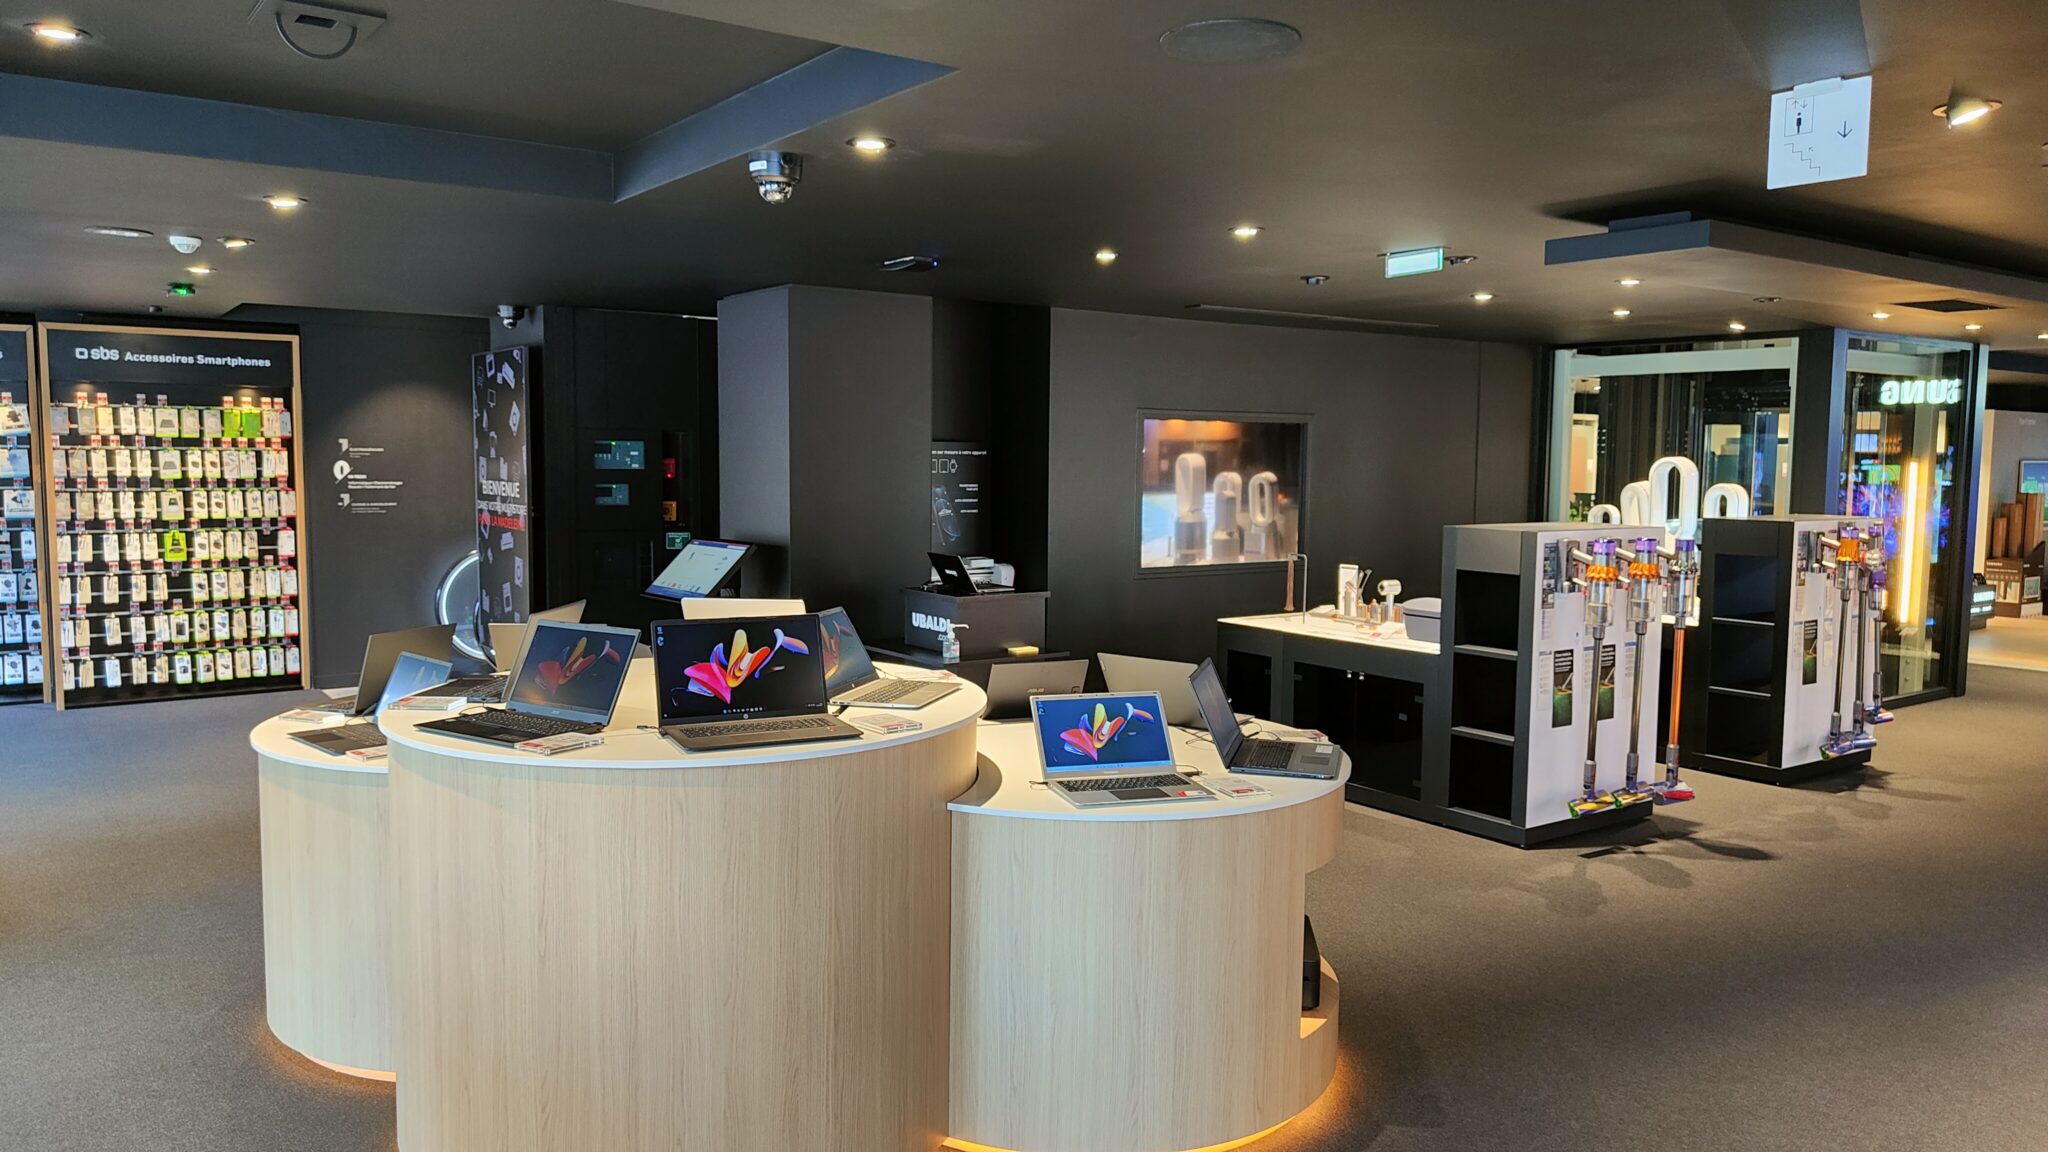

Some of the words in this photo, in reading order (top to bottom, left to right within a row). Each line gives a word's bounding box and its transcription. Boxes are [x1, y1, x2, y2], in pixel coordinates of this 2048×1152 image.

[90, 346, 119, 361] sbs
[124, 352, 195, 364] Accessoires
[196, 354, 271, 368] Smartphones
[482, 480, 520, 498] BIENVENUE
[911, 611, 951, 633] UBALDI
